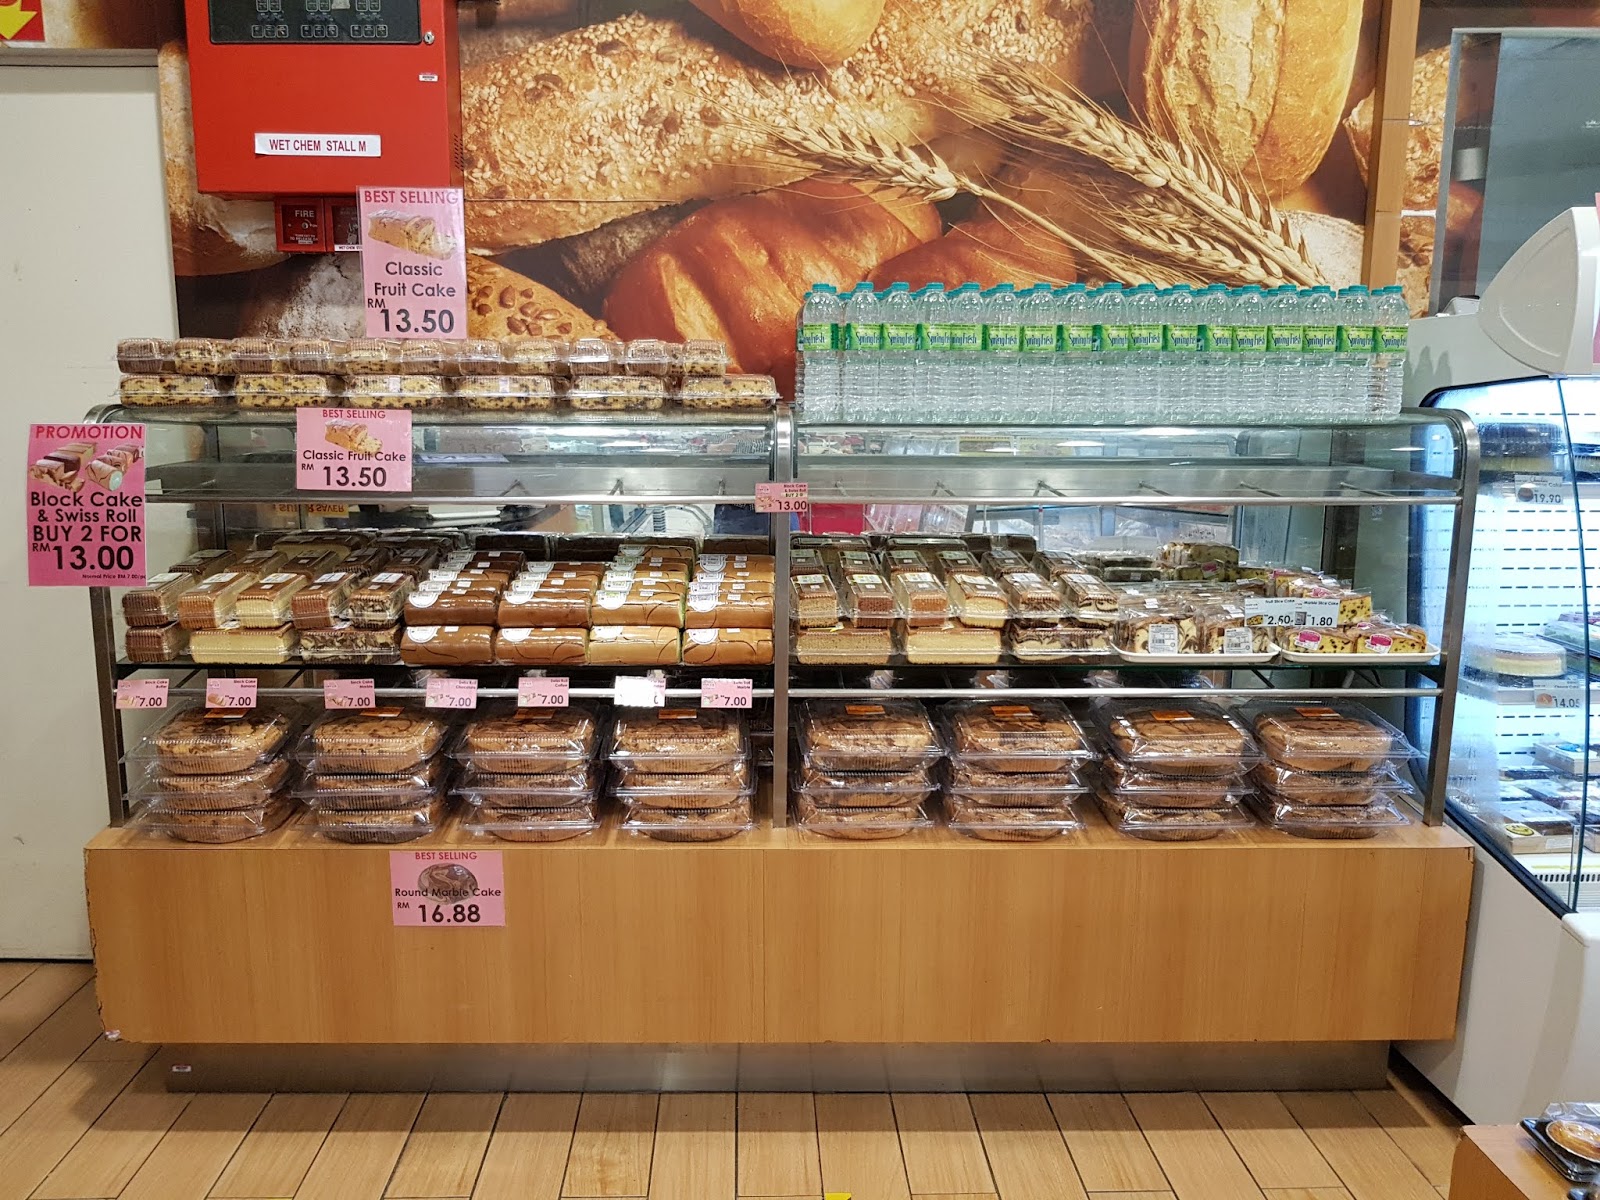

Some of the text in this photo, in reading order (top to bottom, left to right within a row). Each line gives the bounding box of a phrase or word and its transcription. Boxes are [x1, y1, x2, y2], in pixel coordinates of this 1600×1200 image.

[269, 139, 367, 152] WET CHEM STALL M
[364, 190, 458, 204] BEST SELLING
[294, 210, 315, 218] FIRE
[385, 261, 443, 276] Classic
[374, 282, 456, 297] Fruit Cake
[367, 298, 386, 308] RM
[380, 309, 454, 333] 13.50
[322, 409, 386, 419] BEST SELLING
[35, 425, 142, 439] PROMOTION
[303, 450, 406, 462] Classic Fruit Cake
[301, 463, 314, 471] RM
[322, 466, 387, 487] 13.50
[31, 491, 143, 507] Block Cake
[1534, 494, 1561, 503] 19.90
[778, 501, 807, 510] 13.00
[37, 509, 136, 522] & Swiss Roll
[33, 525, 142, 542] BUY 2 FOR
[32, 543, 50, 552] RM
[53, 545, 134, 570] 13.00
[1267, 615, 1291, 625] 2.50
[1311, 616, 1333, 626] 1.80
[140, 697, 162, 707] 7.00
[229, 696, 251, 706] 7.00
[348, 697, 370, 707] 7.00
[449, 697, 471, 707] 7.00
[541, 695, 564, 704] 7.00
[724, 697, 747, 706] 7.00
[1554, 698, 1580, 708] 14.05
[415, 852, 478, 860] BEST SELLING
[395, 888, 501, 897] Round Marble Cake
[418, 904, 481, 923] 16.88
